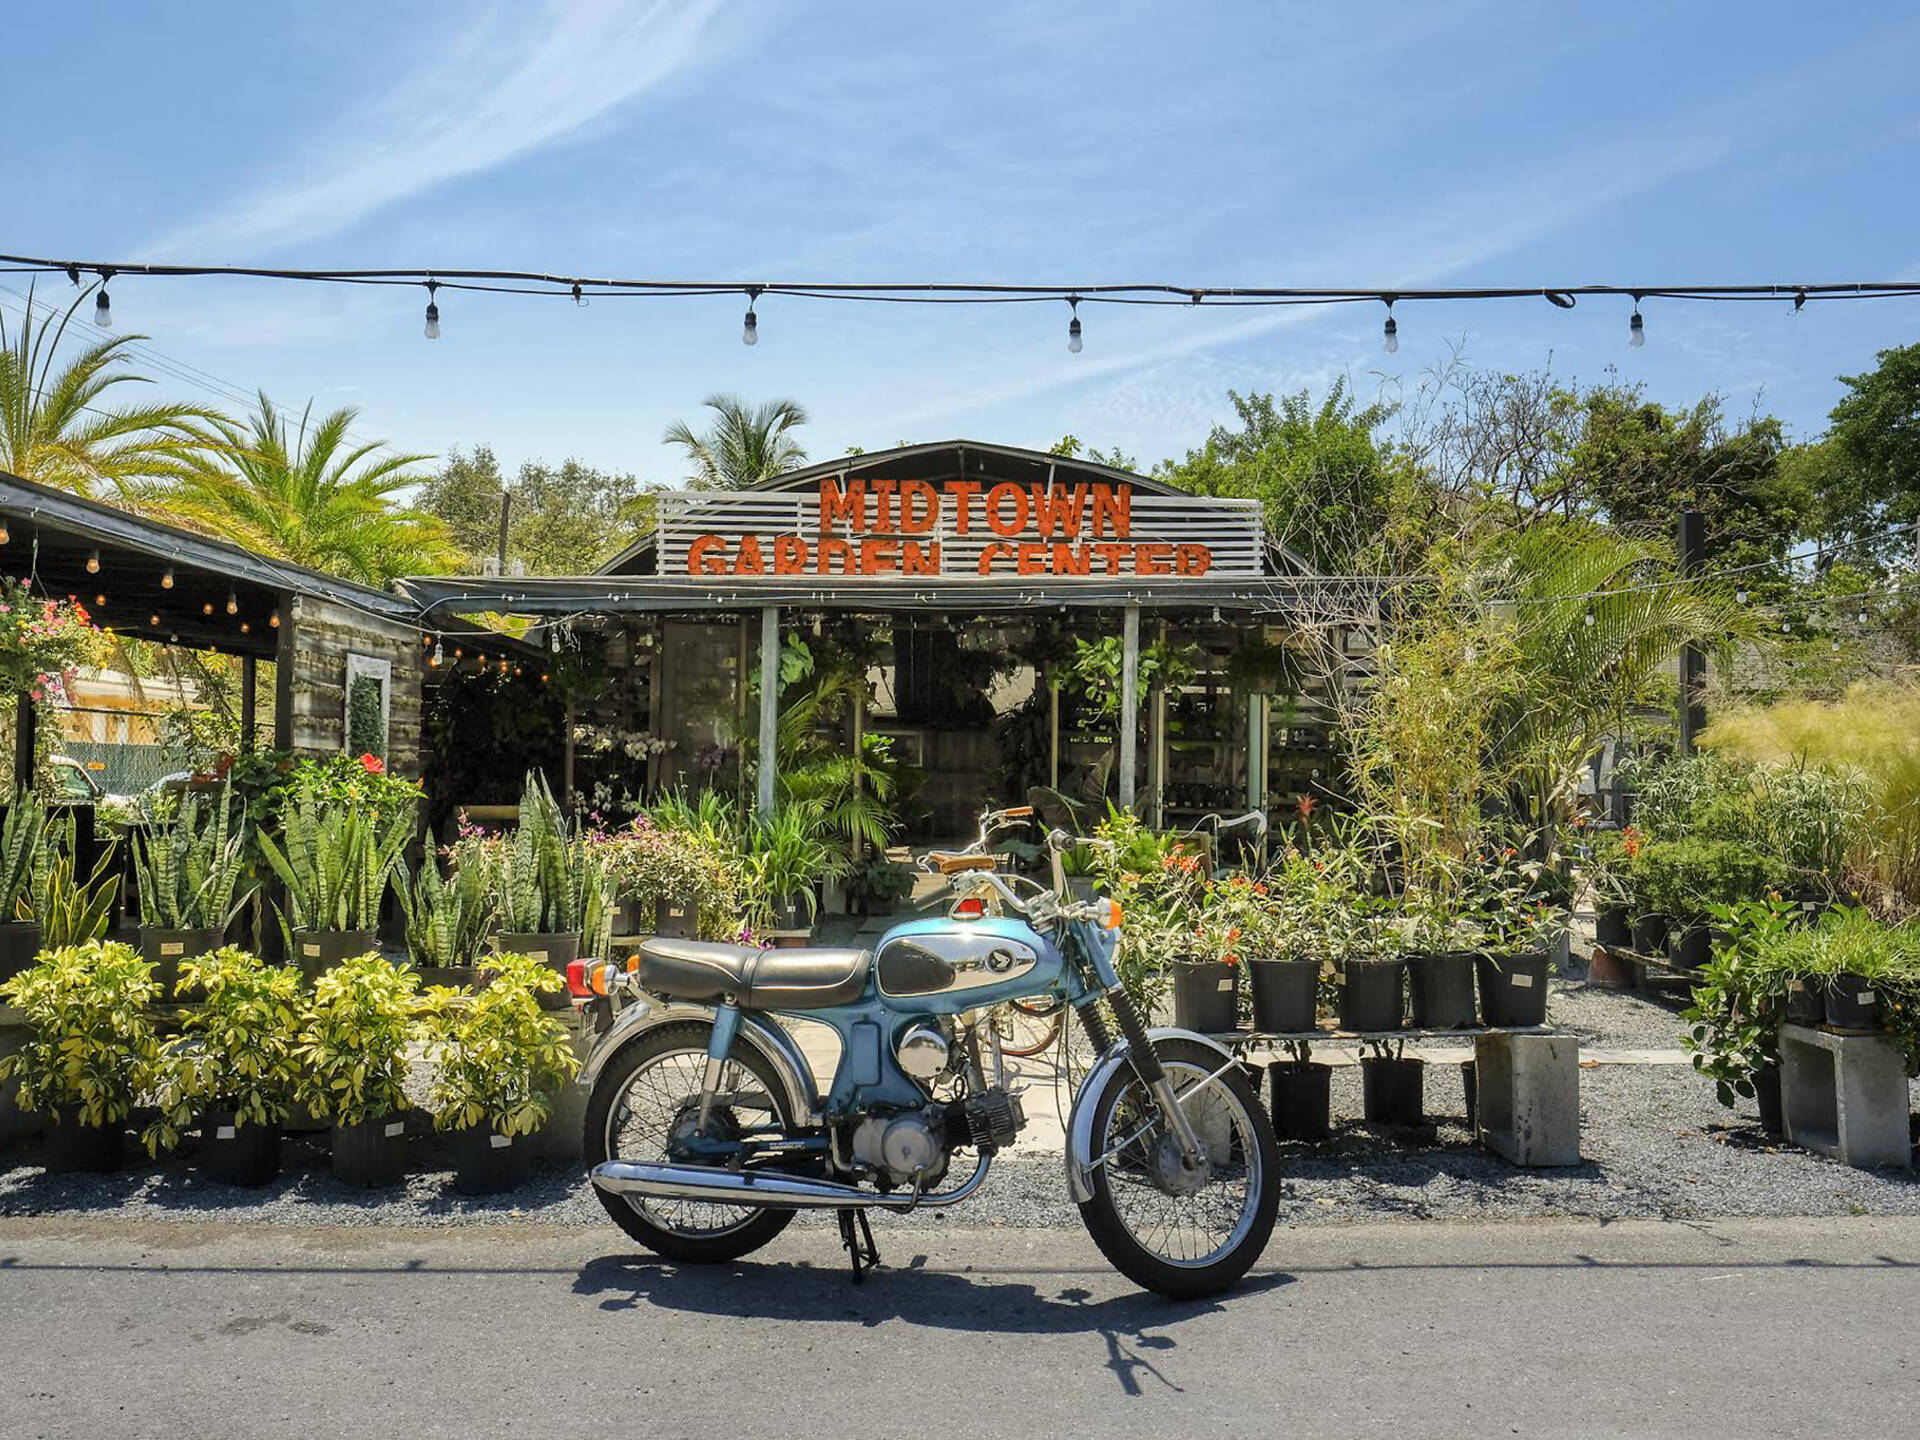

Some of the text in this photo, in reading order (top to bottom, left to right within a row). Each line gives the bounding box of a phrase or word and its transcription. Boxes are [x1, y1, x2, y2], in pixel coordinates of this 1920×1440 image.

[819, 478, 1132, 538] MIDTOWN
[687, 533, 1212, 576] GARDEN CENTER
